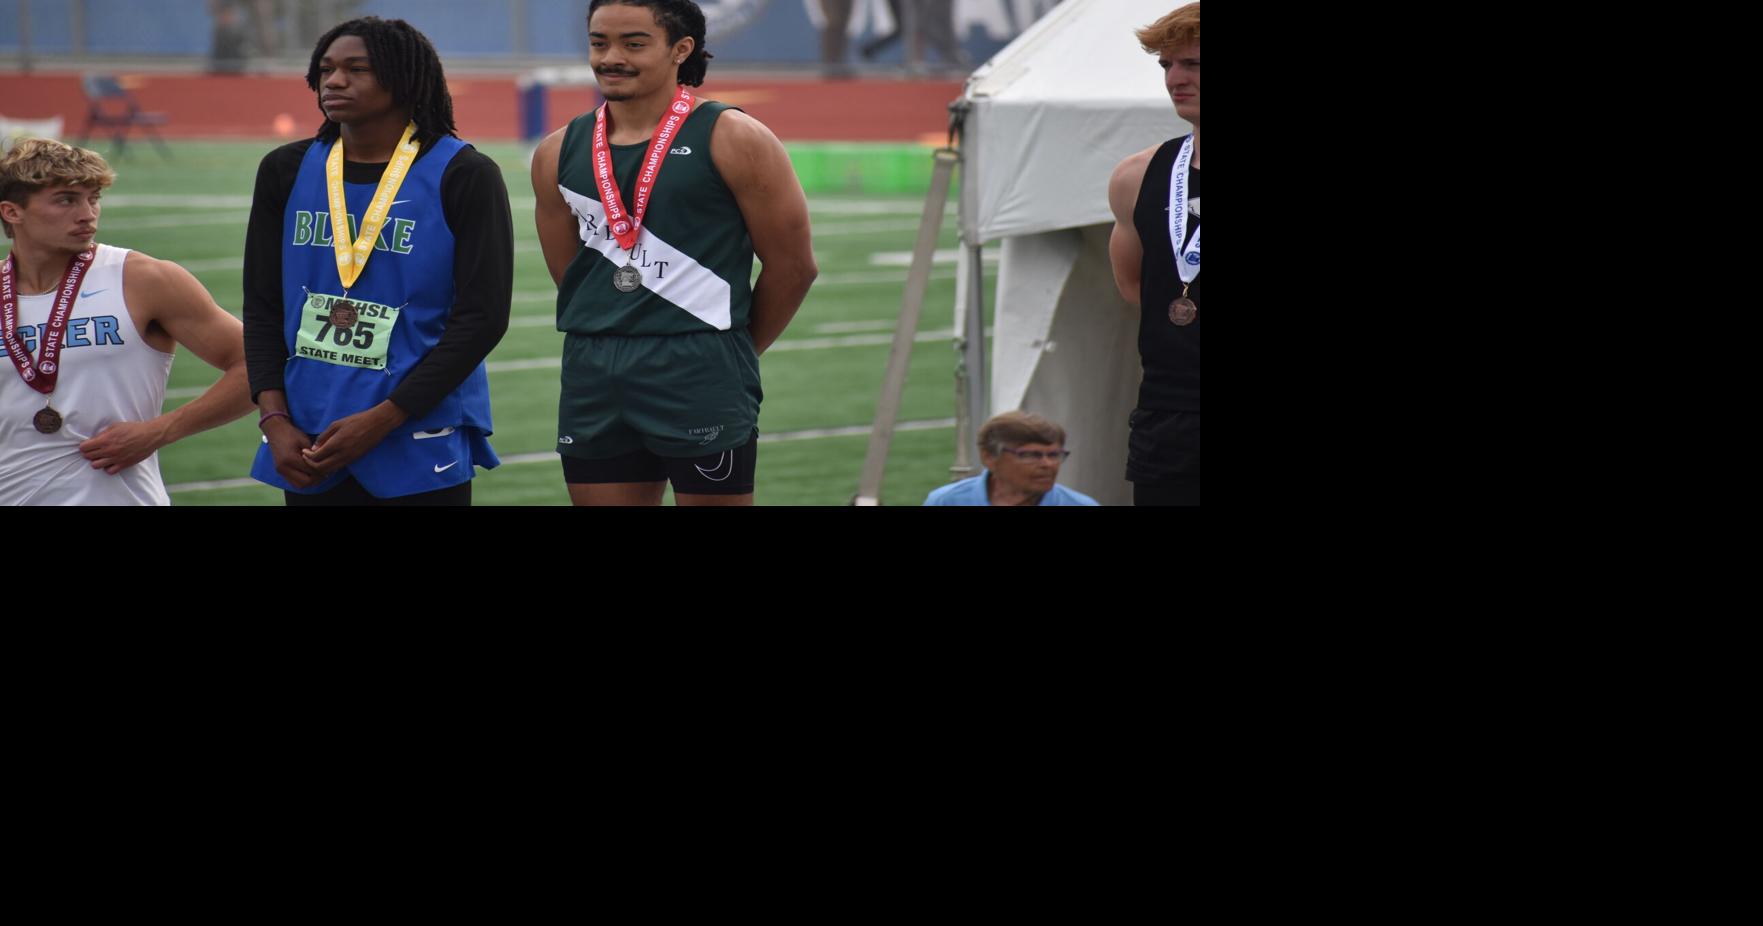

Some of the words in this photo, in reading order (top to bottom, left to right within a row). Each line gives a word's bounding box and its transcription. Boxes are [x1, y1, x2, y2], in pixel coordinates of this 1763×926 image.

[595, 122, 604, 148] STATE
[642, 115, 680, 183] CHAMPIONSHIPS
[1177, 144, 1191, 170] STATE
[596, 150, 621, 220] CHAMPIONSHIPS
[637, 186, 648, 214] STATE
[1, 274, 12, 300] STATE
[45, 331, 59, 358] STATE
[53, 260, 86, 328] CHAMPIONSHIPS
[3, 302, 30, 368] CHAMPIONSHIPS
[314, 315, 375, 350] 765
[300, 346, 337, 360] STATE
